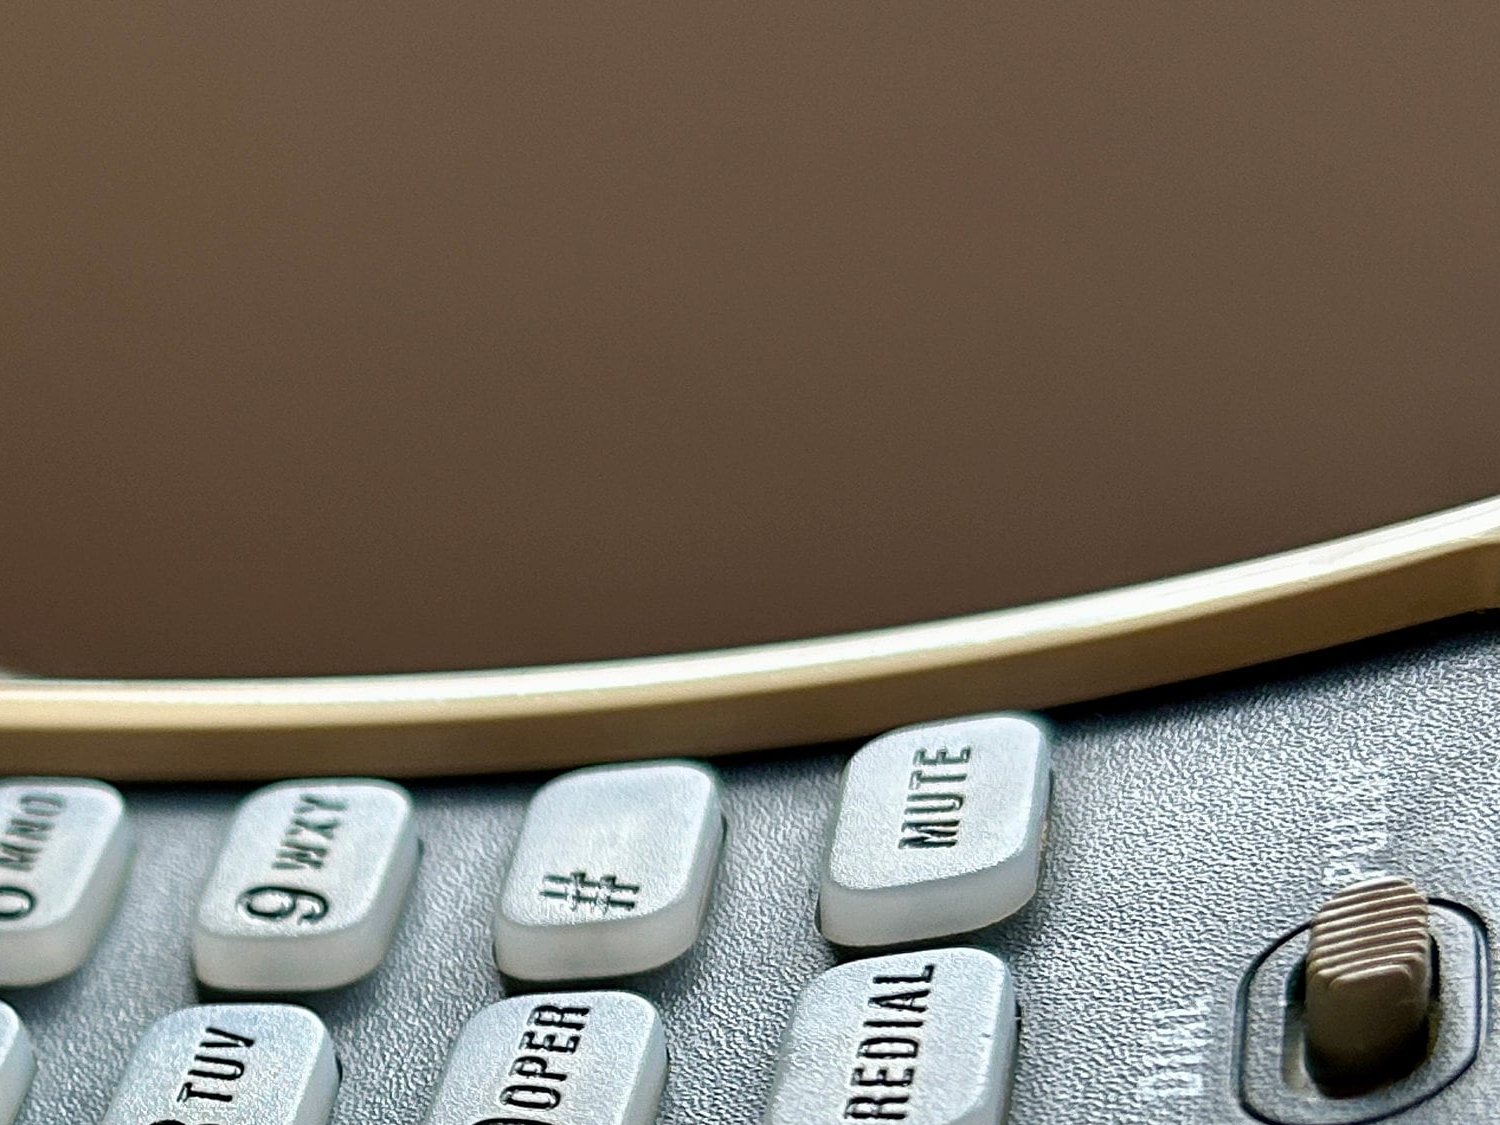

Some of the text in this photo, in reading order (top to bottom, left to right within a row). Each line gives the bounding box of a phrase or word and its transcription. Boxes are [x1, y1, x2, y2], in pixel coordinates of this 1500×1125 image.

[900, 745, 971, 850] MUTE
[237, 793, 349, 925] 9 WXY
[539, 869, 641, 913] #
[176, 1026, 256, 1103] TUV
[500, 1003, 592, 1110] OPER
[844, 963, 935, 1121] REDIAL
